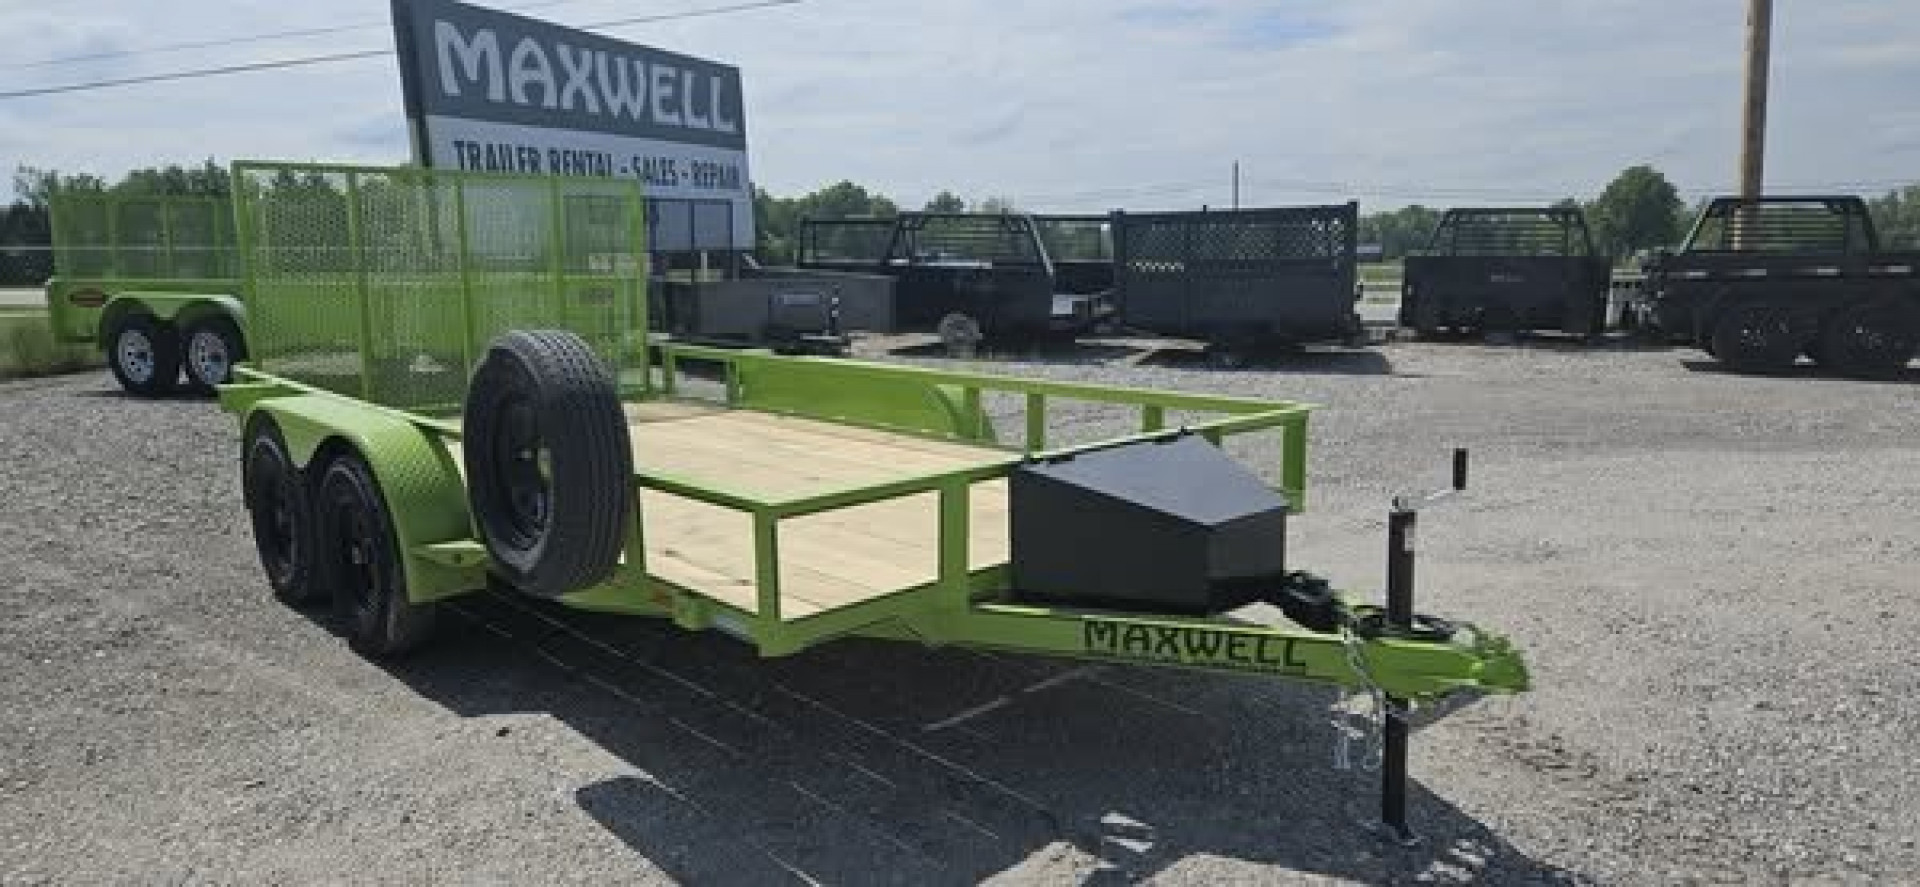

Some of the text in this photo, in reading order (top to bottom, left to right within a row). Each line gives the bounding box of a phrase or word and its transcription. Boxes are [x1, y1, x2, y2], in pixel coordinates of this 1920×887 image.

[434, 19, 736, 132] MAXWELL
[453, 140, 542, 175] TRAILER
[548, 147, 612, 177] RENTAL
[1084, 620, 1307, 668] MAXWELL
